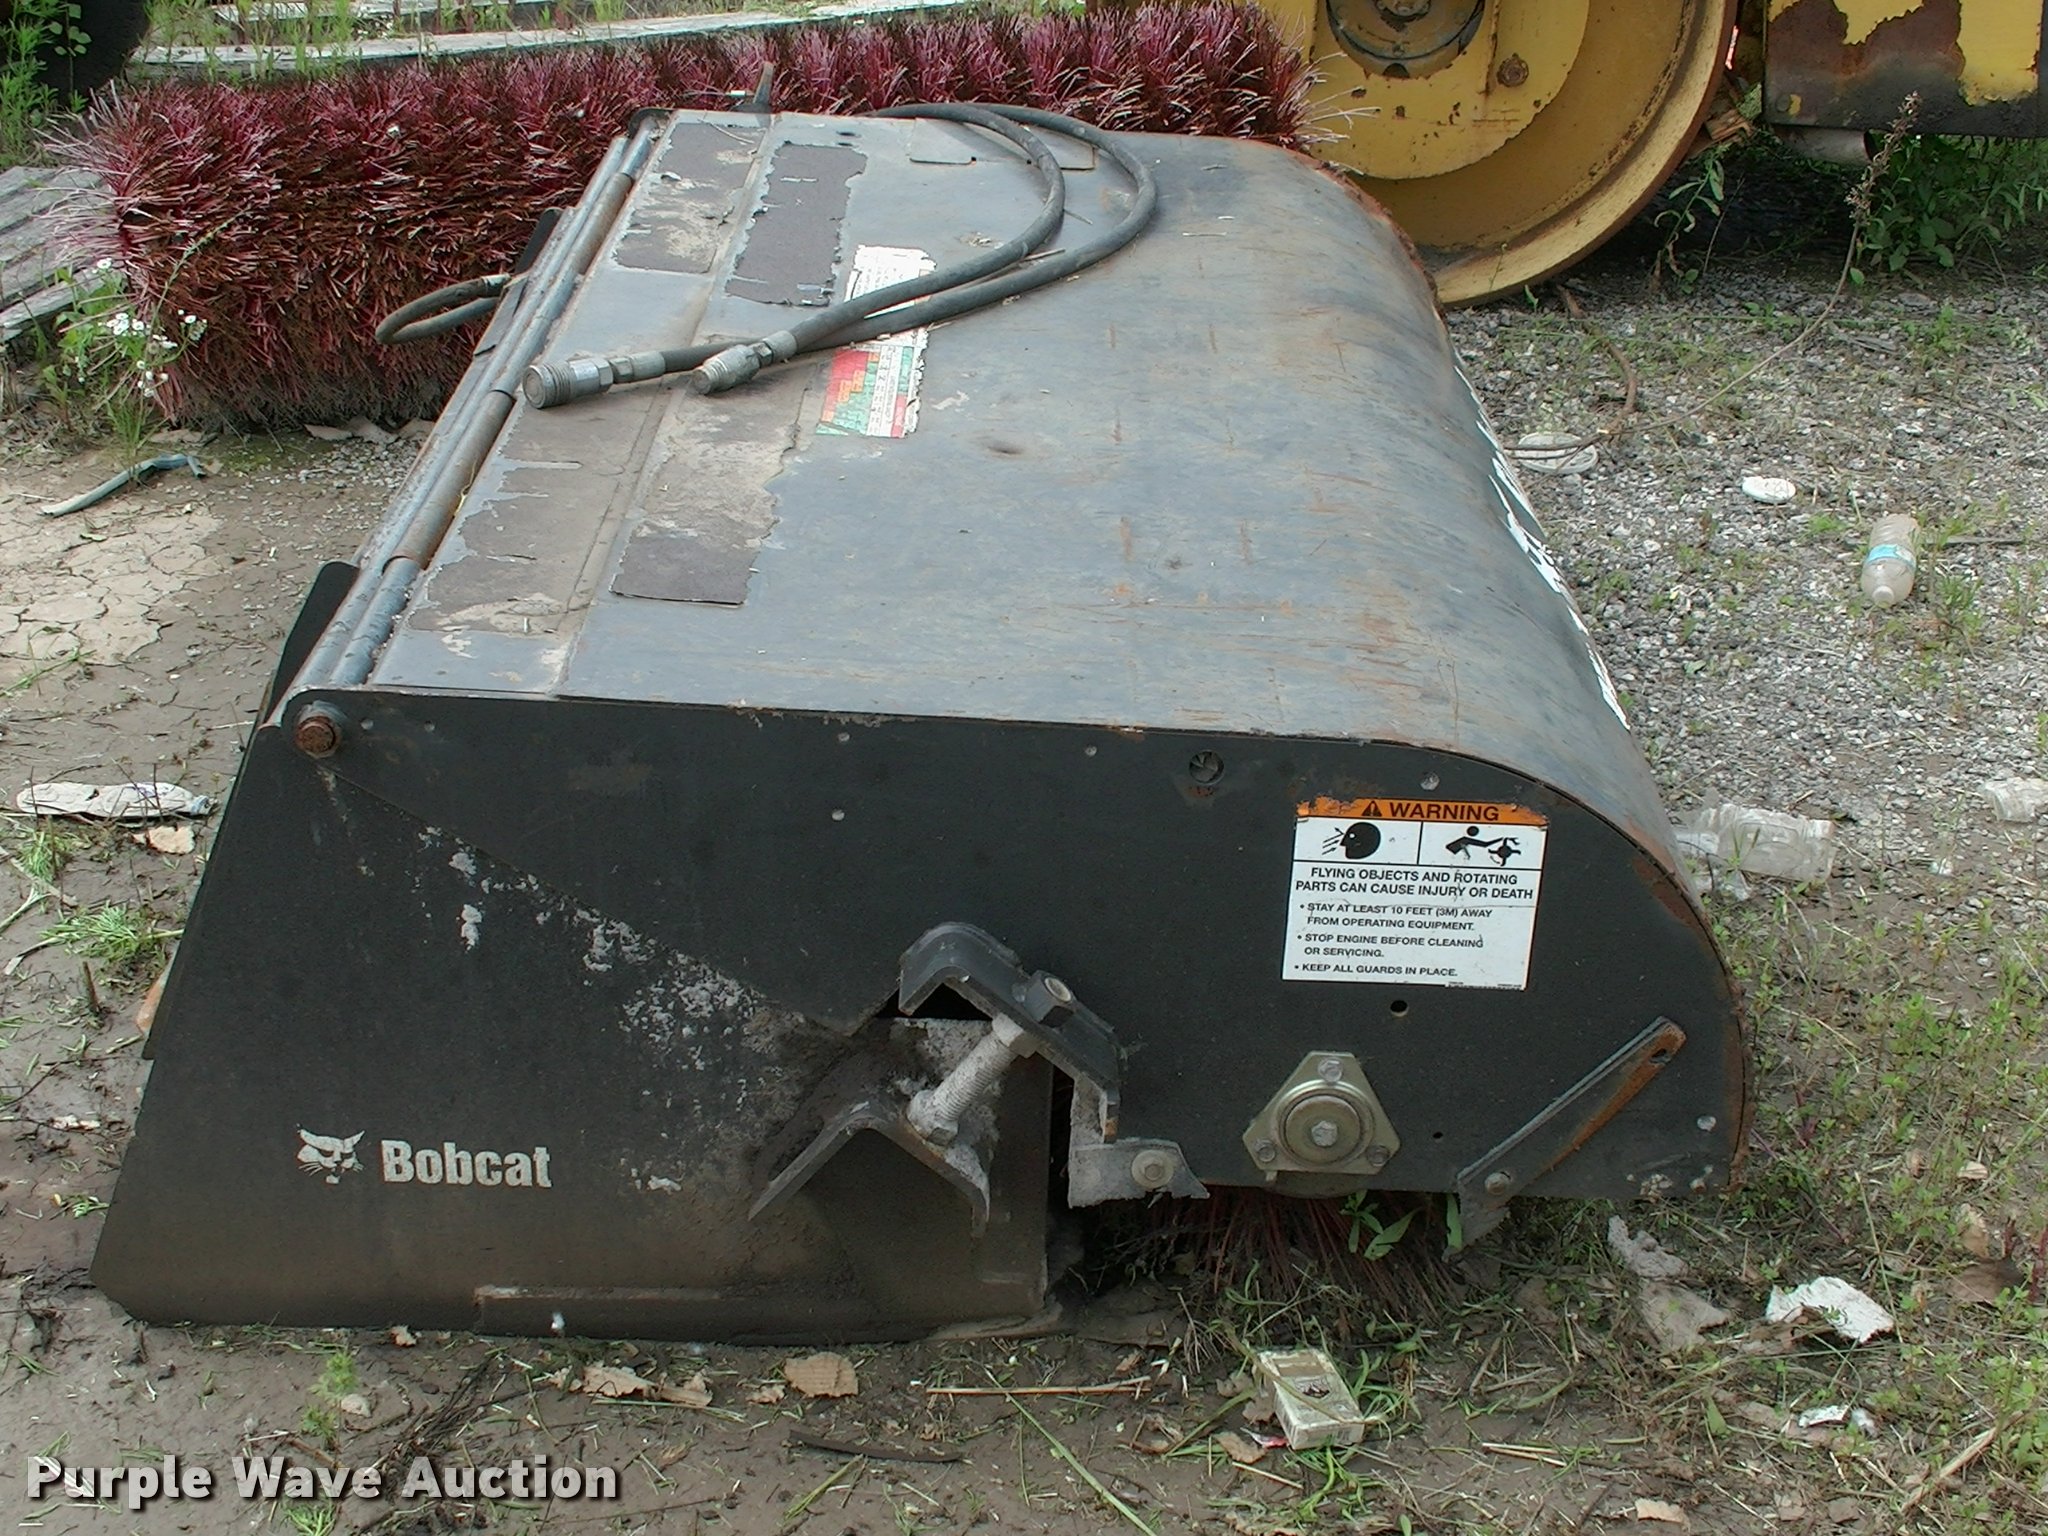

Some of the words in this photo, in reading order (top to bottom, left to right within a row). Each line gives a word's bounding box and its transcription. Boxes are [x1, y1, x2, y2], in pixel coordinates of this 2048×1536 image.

[1389, 802, 1500, 822] WARNING
[1311, 867, 1355, 879] FLYING
[1359, 869, 1419, 881] OBJECTS
[1422, 871, 1450, 882] AND
[1454, 872, 1518, 885] ROTATING
[1295, 880, 1336, 892] PARTS
[1339, 882, 1367, 893] CAN
[1370, 883, 1415, 895] CAUSE
[1418, 885, 1466, 897] INJURY
[1469, 887, 1488, 898] OR
[1491, 888, 1533, 899] DEATH
[1307, 902, 1335, 912] STAY
[1336, 904, 1350, 913] AT
[1353, 904, 1388, 914] LEAST
[1391, 906, 1403, 914] 10
[1405, 906, 1433, 915] FEET
[1435, 907, 1458, 918] (3M)
[1460, 908, 1493, 918] AWAY
[1307, 916, 1339, 926] FROM
[1342, 917, 1405, 928] OPERATING
[1407, 920, 1475, 931] EQUIPMENT.
[1305, 933, 1334, 942] STOP
[1336, 934, 1378, 944] ENGINE
[1380, 936, 1425, 946] BEFORE
[1427, 937, 1484, 948] CLEANING
[1304, 946, 1320, 955] OR
[1322, 947, 1385, 958] SERVICING.
[1302, 963, 1331, 972] KEEP
[1333, 964, 1354, 973] ALL
[1356, 965, 1403, 975] GUARDS
[1405, 967, 1417, 975] IN
[1419, 967, 1458, 977] PLACE.
[381, 1139, 552, 1188] Bobcat
